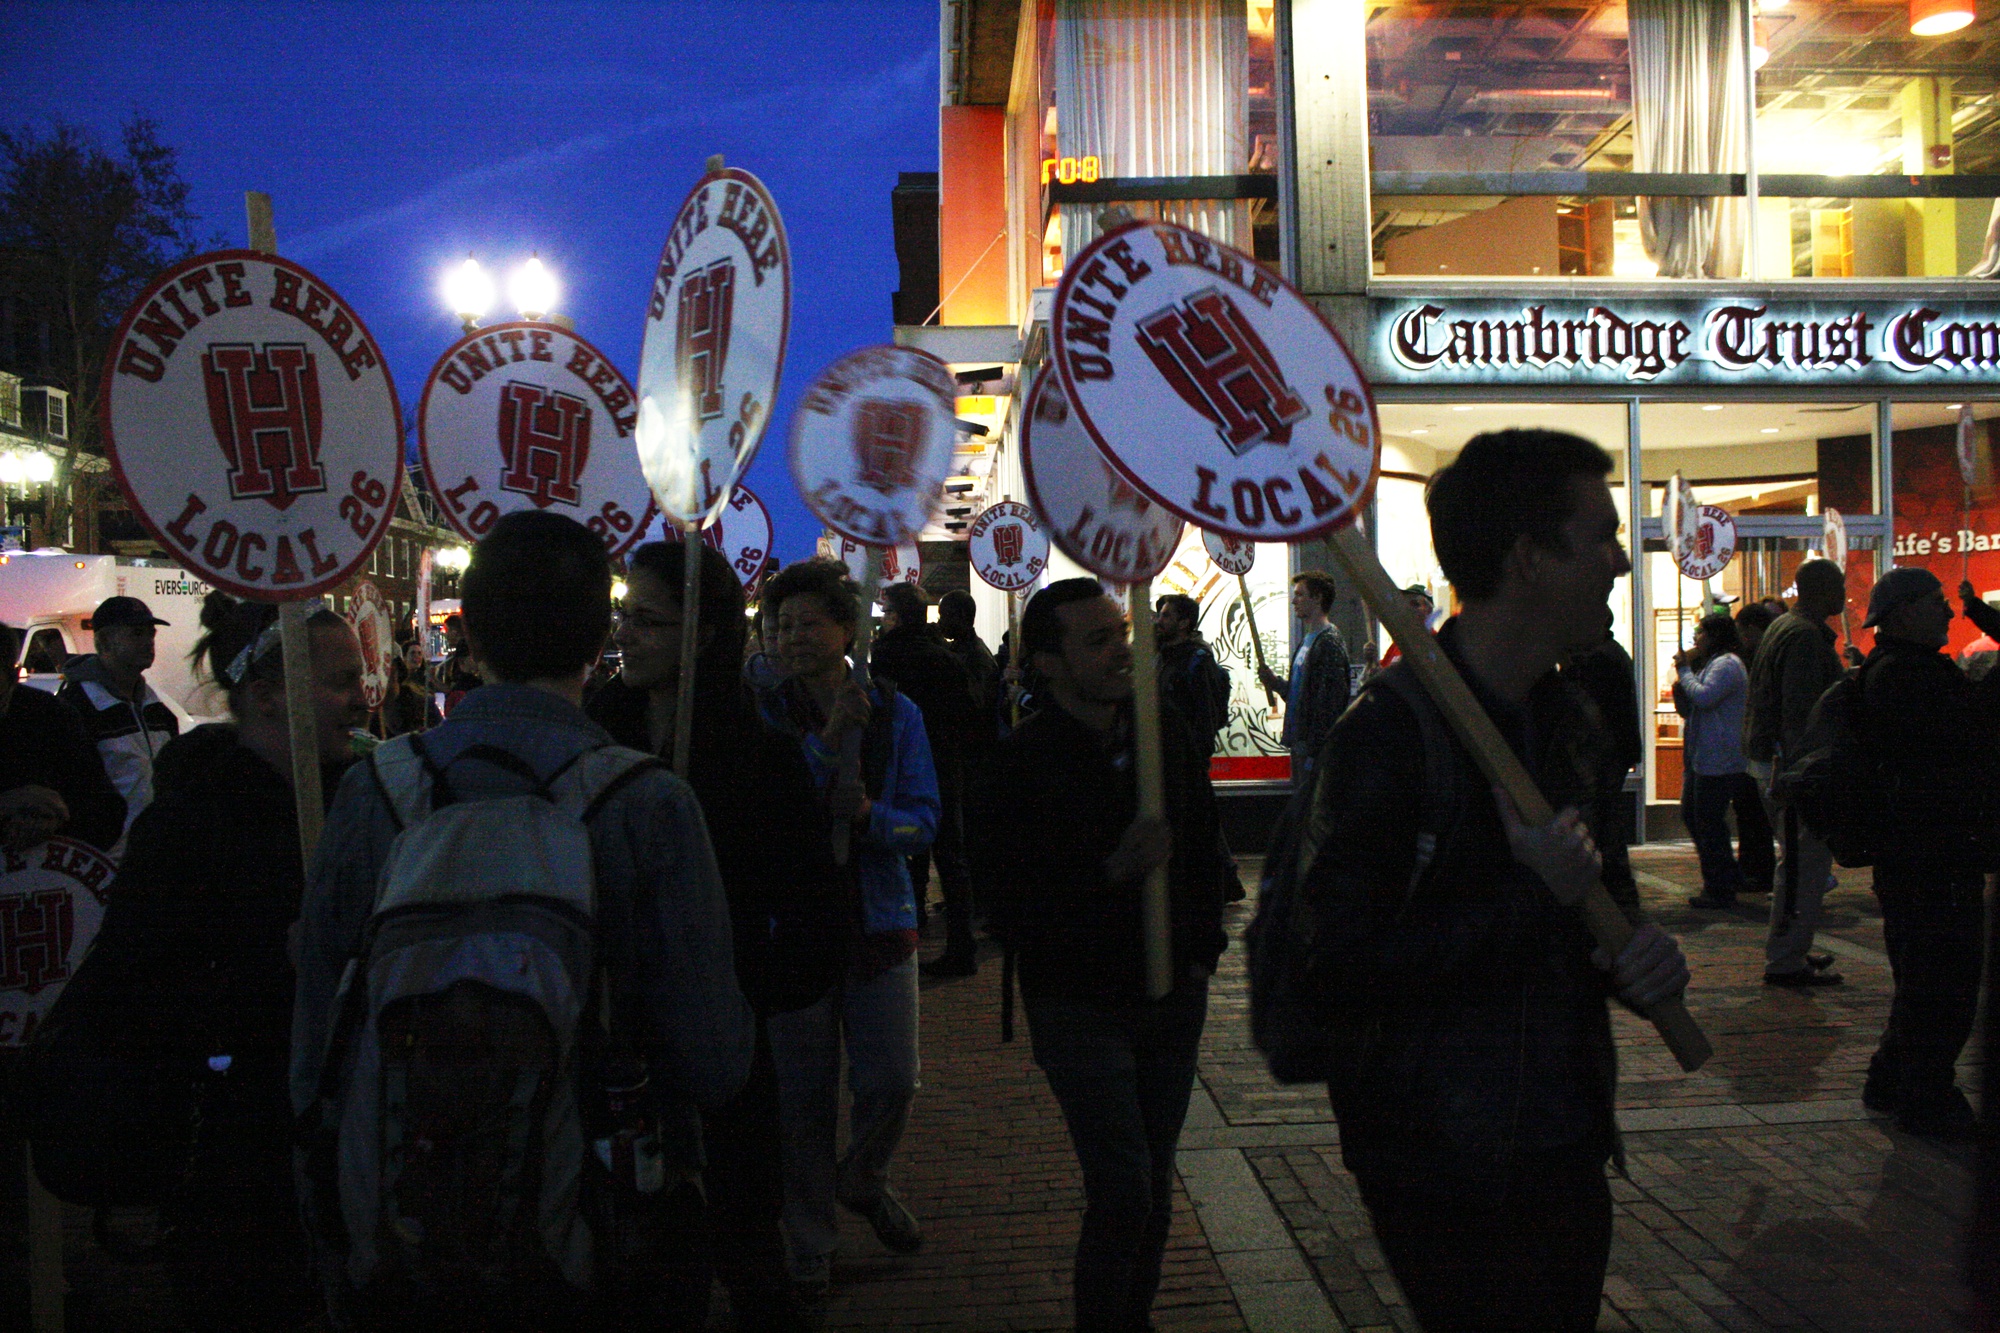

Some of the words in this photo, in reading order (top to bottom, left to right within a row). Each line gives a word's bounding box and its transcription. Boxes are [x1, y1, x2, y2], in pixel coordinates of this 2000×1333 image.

[648, 186, 710, 322] UNITE
[717, 182, 780, 287] HERE
[117, 262, 253, 383] UNITE
[270, 267, 376, 382] HERE
[1065, 238, 1152, 384] UNITE
[1154, 229, 1284, 309] HERE
[1390, 304, 1691, 380] Cambridge
[1706, 304, 1874, 372] Trust
[440, 330, 554, 395] UNITE
[566, 344, 638, 438] HERE
[1134, 284, 1313, 458] H
[207, 342, 327, 501] H
[499, 379, 588, 508] H
[1191, 452, 1363, 528] LOCAL
[1324, 383, 1369, 450] 26
[165, 494, 338, 585] LOCAL
[340, 470, 386, 541] 26
[973, 504, 1007, 538] UNITE
[994, 522, 1024, 566] H
[1702, 507, 1731, 527] HERE
[1893, 531, 1952, 556] ife's
[734, 546, 763, 576] 26
[981, 563, 1025, 587] LOCAL
[1026, 556, 1043, 575] 26
[1215, 552, 1247, 572] LOCAL
[1681, 561, 1717, 577] LOCAL
[41, 847, 108, 906] HER
